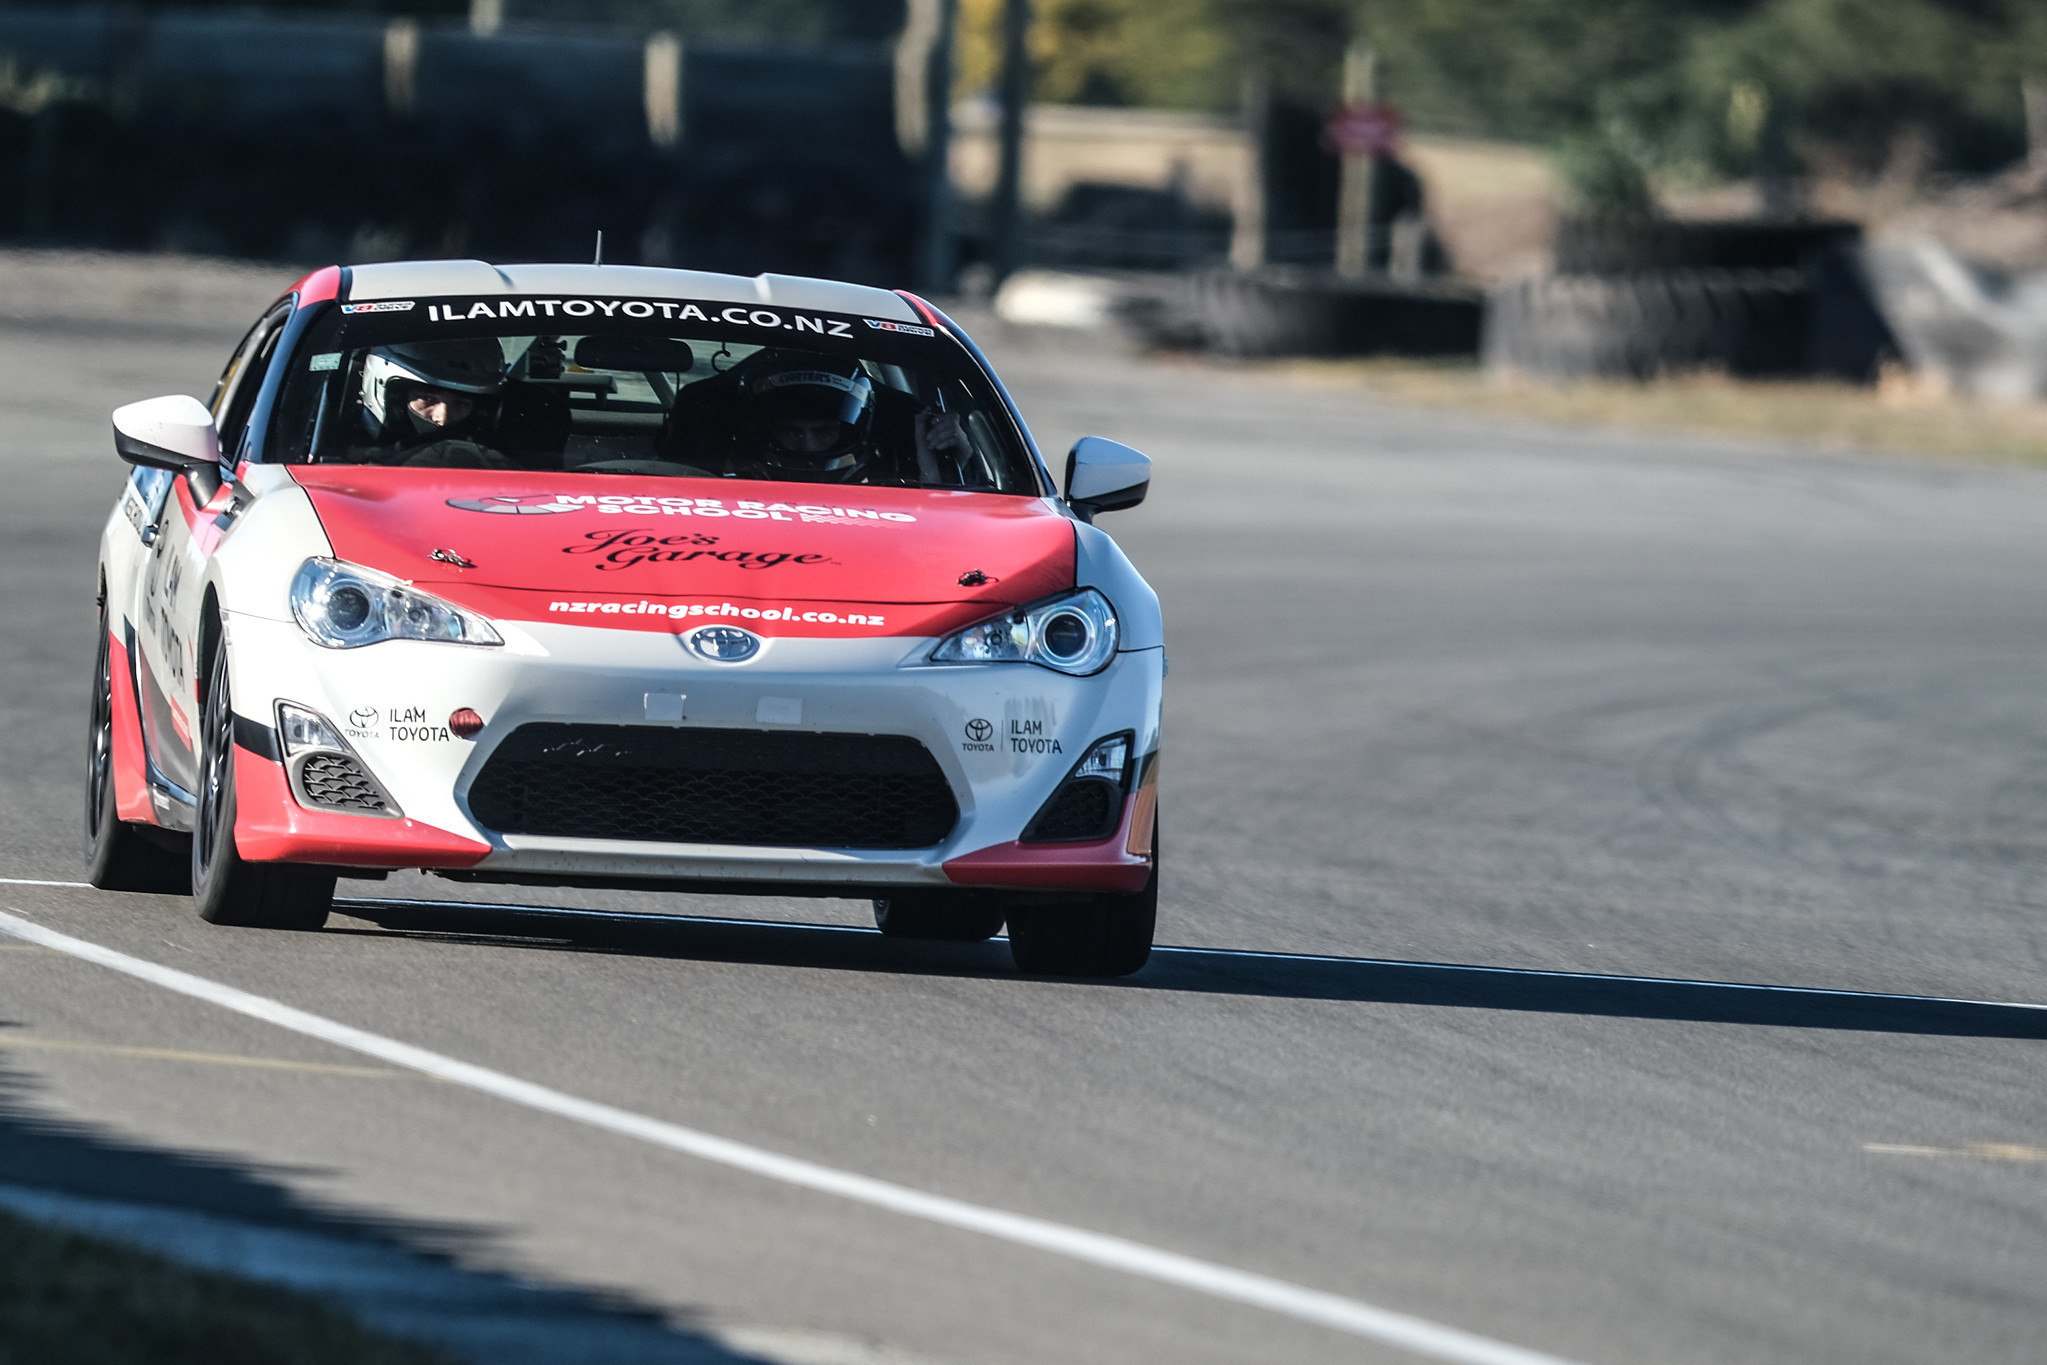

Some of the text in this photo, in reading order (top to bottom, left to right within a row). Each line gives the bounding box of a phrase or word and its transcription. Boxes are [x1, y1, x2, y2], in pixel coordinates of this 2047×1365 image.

[428, 300, 854, 338] ILAMTOYOTA.CO.NZ
[555, 494, 917, 523] MOTOR RACING
[597, 504, 793, 521] SCHOOL
[561, 528, 720, 554] Joe's
[595, 546, 833, 571] Garage
[549, 600, 884, 626] nzracingschool.co.nz
[389, 706, 426, 723] ILAM
[344, 728, 380, 739] TOYOTA
[389, 726, 450, 742] TOYOTA
[1010, 719, 1043, 736] ILAM
[962, 742, 995, 752] TOYOTA
[1010, 738, 1063, 754] TOYOTA
